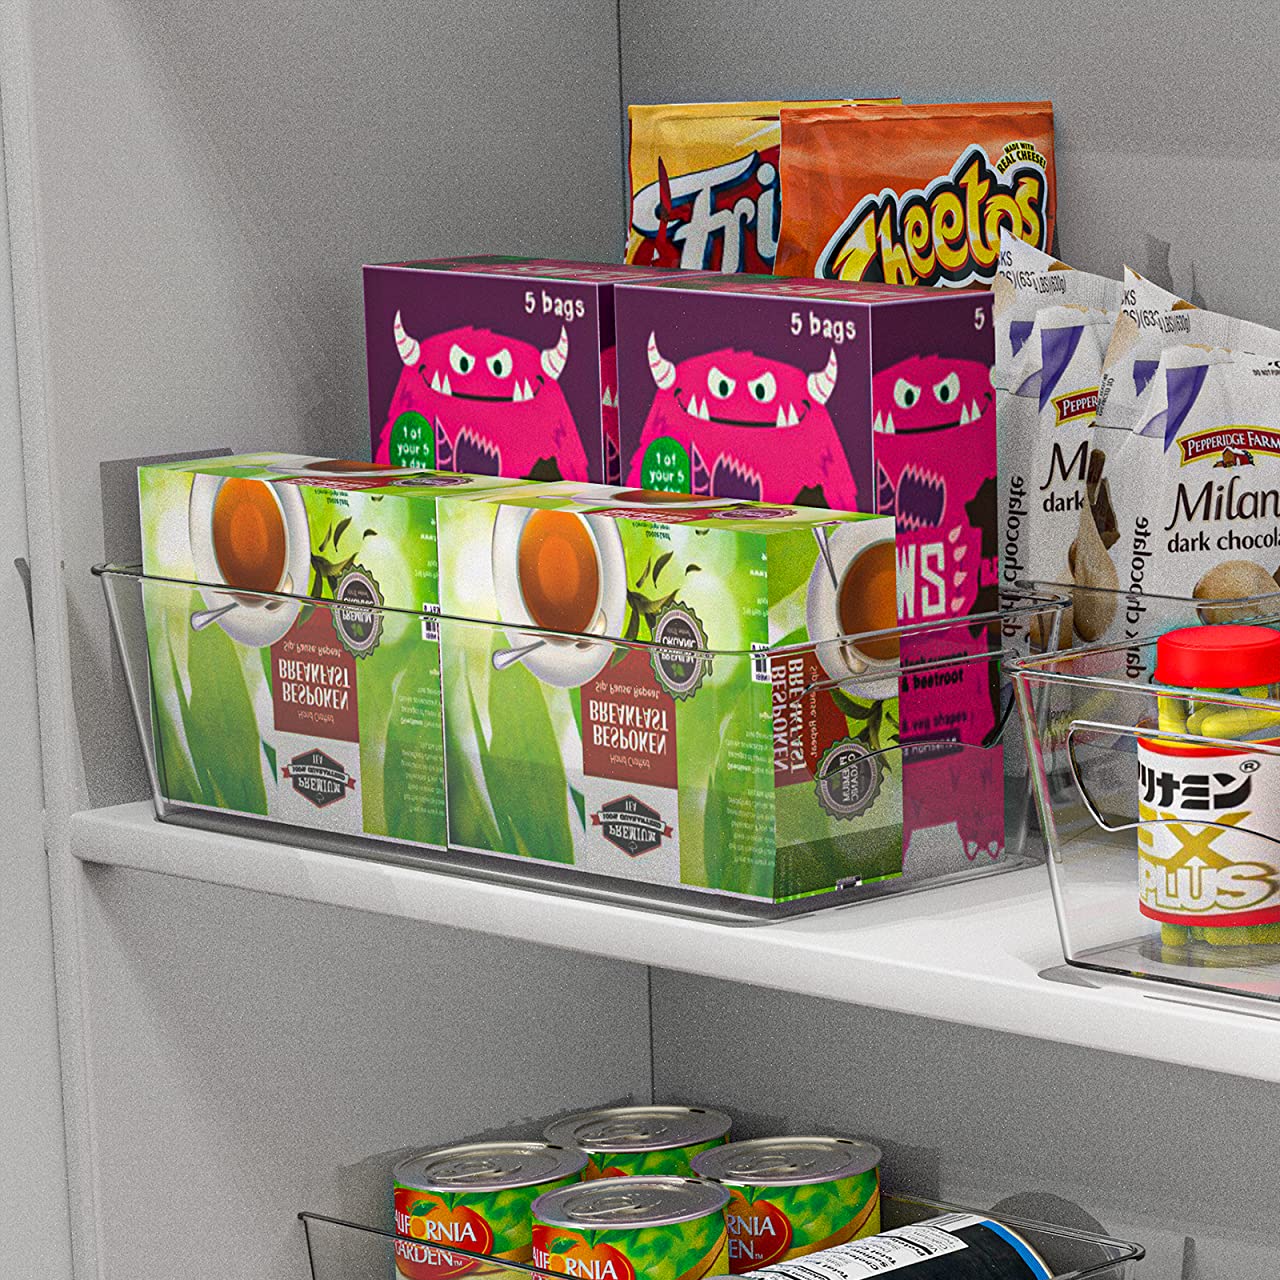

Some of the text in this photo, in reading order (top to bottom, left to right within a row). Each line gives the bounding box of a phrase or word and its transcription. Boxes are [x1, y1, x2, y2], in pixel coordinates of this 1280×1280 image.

[997, 150, 1046, 174] REAL CHEESE!
[525, 290, 585, 320] 5 bags
[791, 311, 857, 340] 5 bags
[397, 444, 419, 455] your
[1188, 433, 1245, 457] PEPPERIDGE
[648, 470, 684, 484] your 5
[1043, 491, 1085, 513] dark
[1167, 532, 1210, 553] dark
[913, 668, 963, 689] beetroot
[1138, 762, 1252, 810] リナミン
[1139, 861, 1280, 912] PLUS
